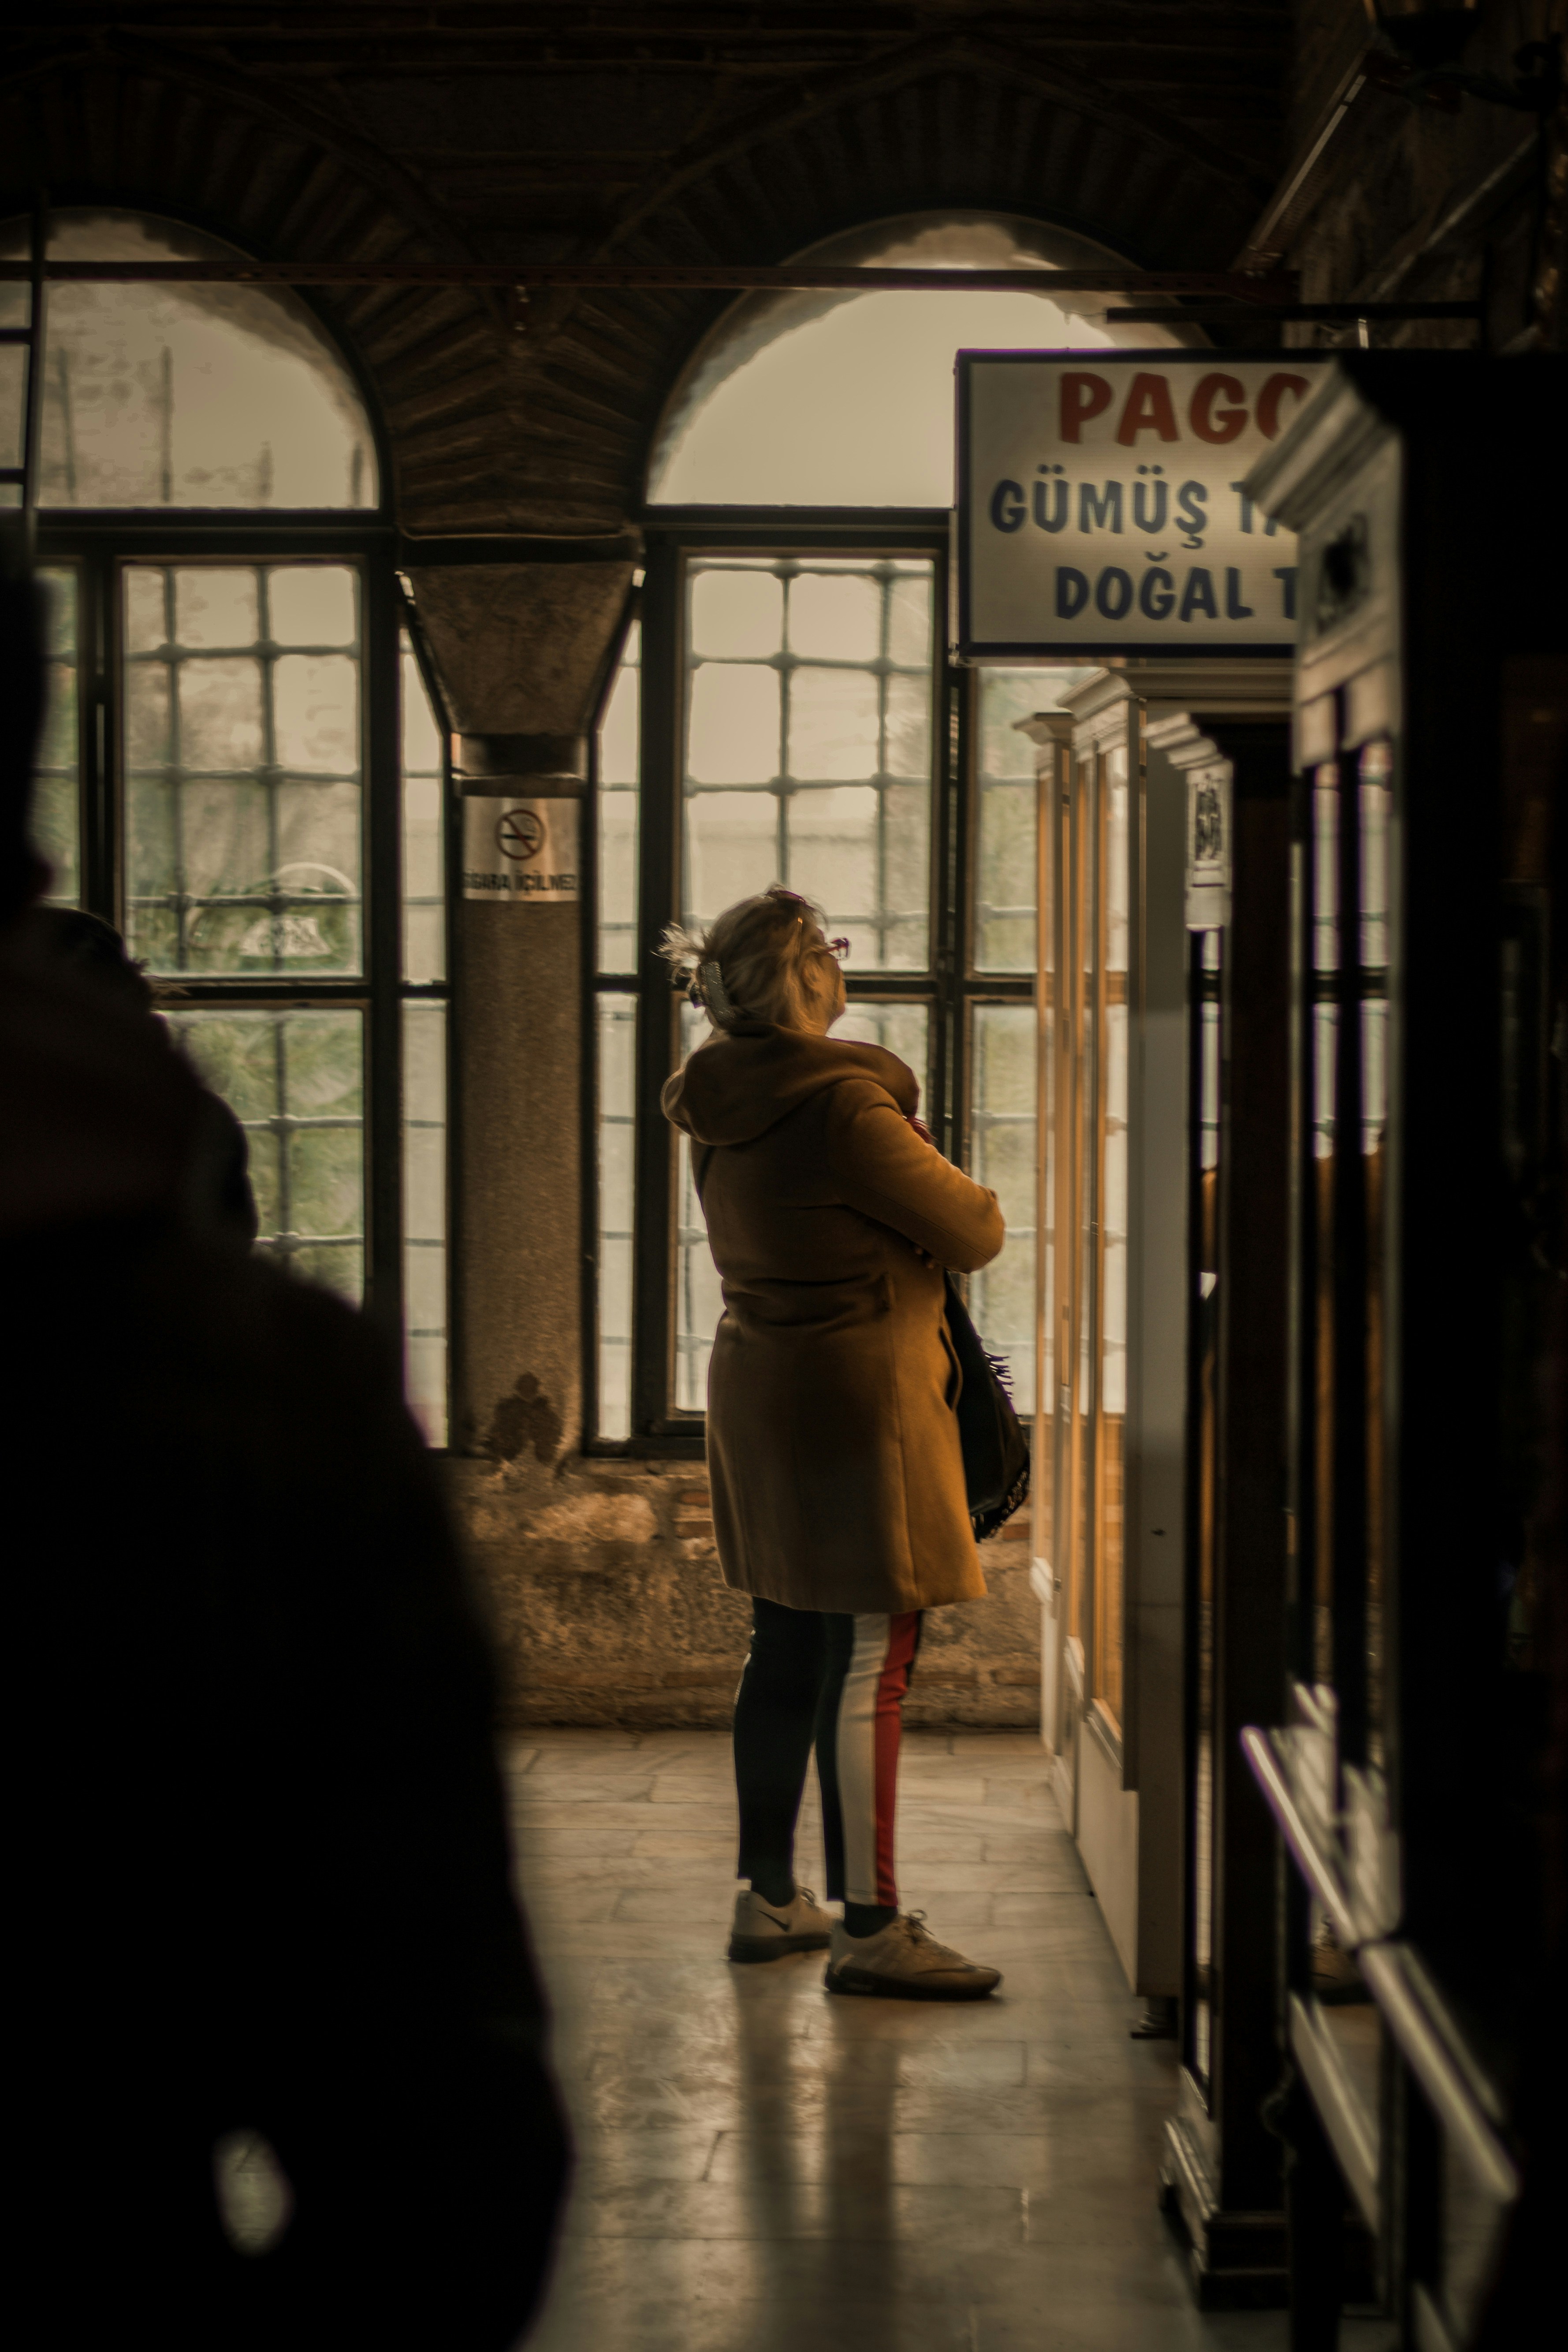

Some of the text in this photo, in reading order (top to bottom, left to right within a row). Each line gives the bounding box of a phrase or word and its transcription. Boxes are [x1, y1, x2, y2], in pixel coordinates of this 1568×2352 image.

[990, 464, 1277, 550] GÜMÜŞ T
[1055, 551, 1254, 622] DOĞAL
